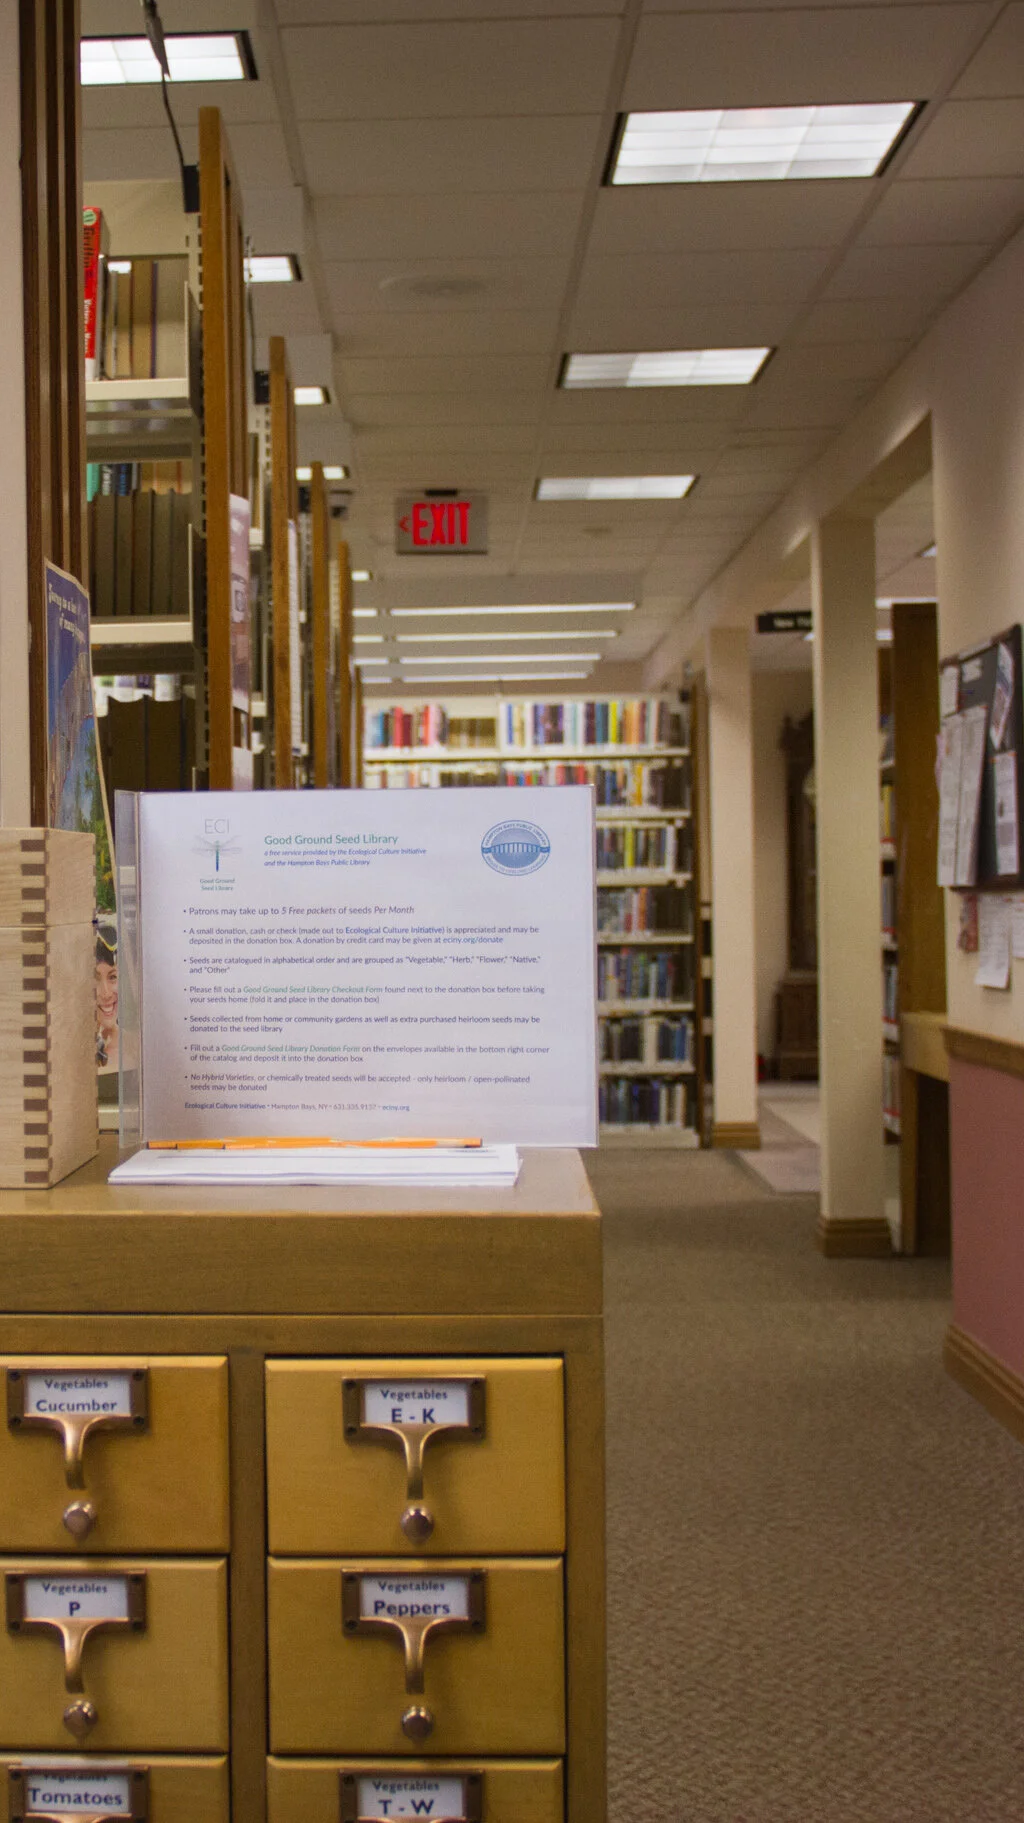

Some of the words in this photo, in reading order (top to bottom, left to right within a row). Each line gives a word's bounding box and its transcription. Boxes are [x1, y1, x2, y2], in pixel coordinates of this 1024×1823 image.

[413, 503, 471, 545] EXIT
[204, 819, 231, 835] ECI
[264, 835, 292, 846] Good
[295, 835, 333, 846] Ground
[335, 834, 361, 845] Seed
[363, 834, 399, 847] Library
[189, 908, 219, 916] Patrons
[221, 909, 237, 917] may
[240, 908, 257, 916] take
[258, 908, 269, 917] up
[271, 908, 280, 916] to
[281, 907, 287, 915] 5
[289, 907, 305, 915] Free
[307, 907, 337, 916] packets
[338, 907, 347, 915] of
[349, 907, 372, 915] seeds
[374, 907, 387, 915] Per
[388, 906, 415, 914] Month
[346, 927, 382, 936] Ecological
[454, 927, 497, 936] appreciated
[189, 938, 224, 946] deposited
[234, 937, 245, 945] the
[303, 937, 335, 945] donation
[337, 937, 345, 946] by
[413, 937, 433, 945] given
[190, 957, 210, 965] Seeds
[224, 957, 262, 966] catalogued
[272, 957, 315, 966] alphabetical
[365, 956, 395, 965] grouped
[190, 967, 203, 975] and
[45, 1379, 108, 1392] Vegetables
[381, 1389, 447, 1402] Vegetables
[36, 1399, 117, 1411] Cucumber
[392, 1408, 402, 1423] E
[423, 1408, 435, 1424] K
[42, 1583, 107, 1595] Vegetables
[379, 1581, 445, 1593] Vegetables
[69, 1602, 80, 1616] P
[374, 1600, 450, 1617] Peppers
[373, 1780, 439, 1793] Vegetables
[28, 1788, 122, 1805] Tomatoes
[379, 1800, 392, 1814] T
[411, 1800, 434, 1814] W
